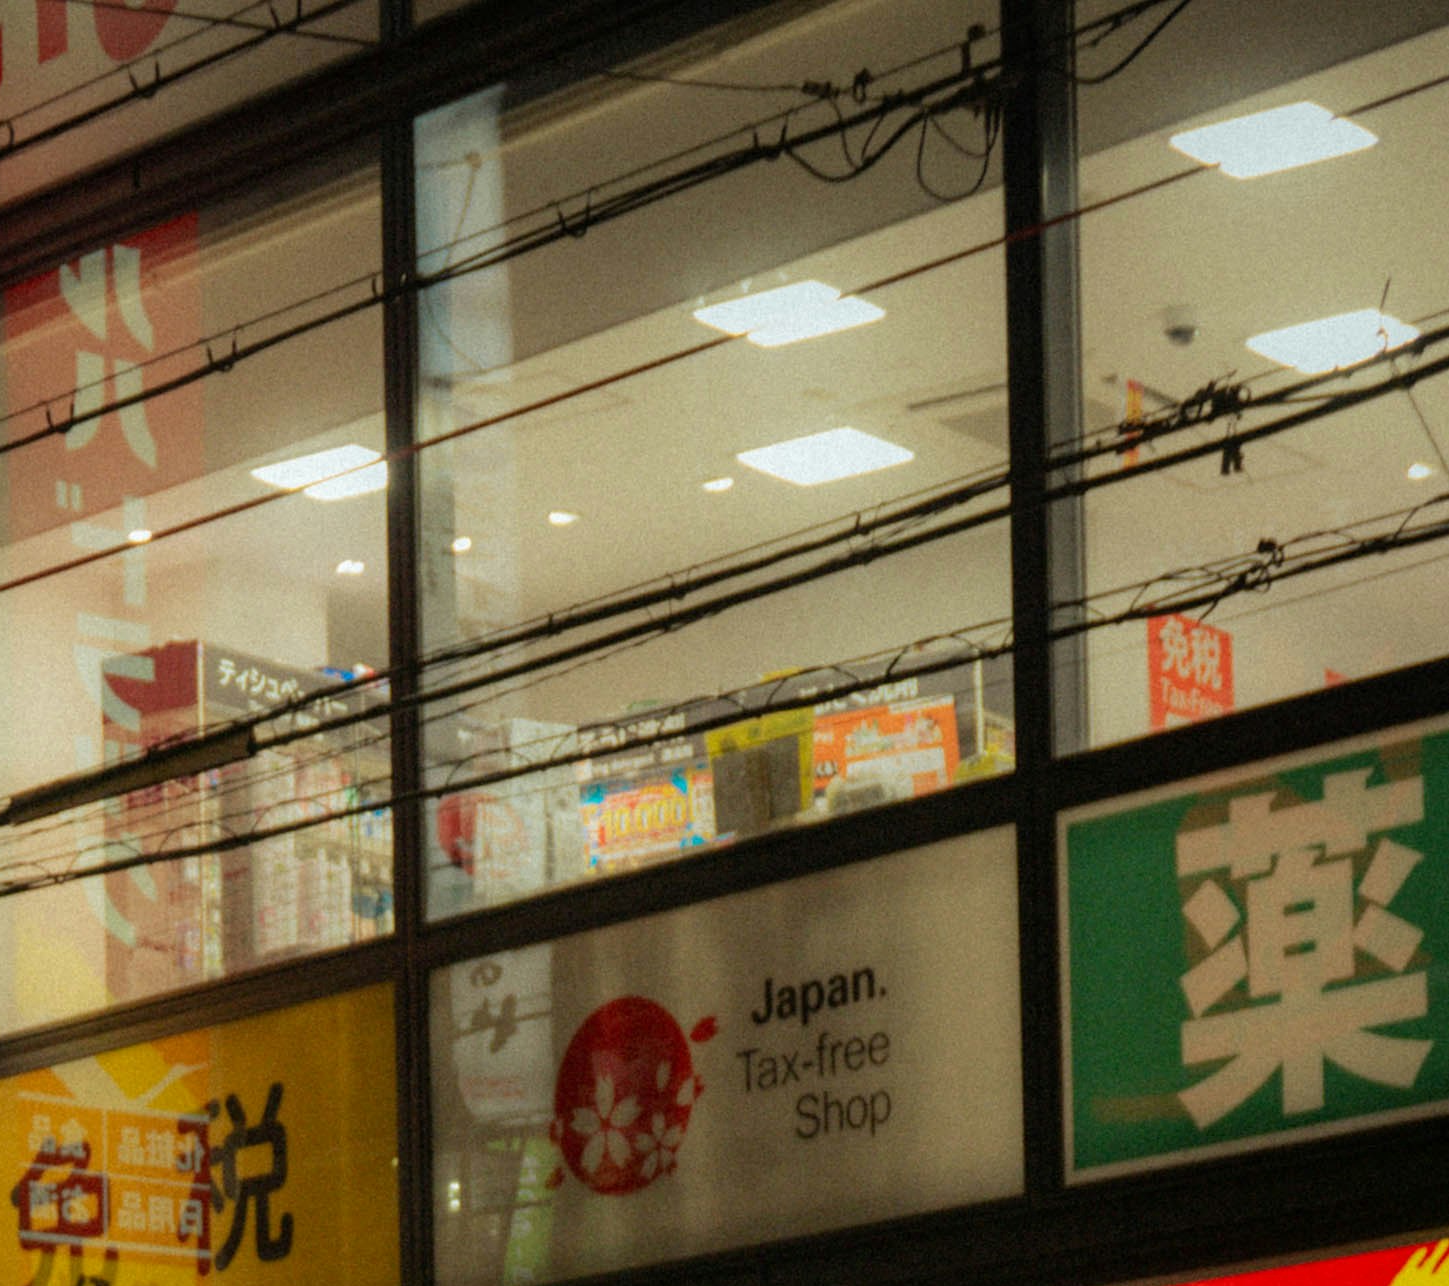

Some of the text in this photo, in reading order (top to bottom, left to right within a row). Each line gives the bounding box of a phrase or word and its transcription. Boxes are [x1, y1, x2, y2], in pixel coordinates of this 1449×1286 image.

[1176, 766, 1435, 1131] 薬
[753, 965, 888, 1026] Japan.
[736, 1030, 892, 1093] Tax-free
[794, 1090, 892, 1139] Shop
